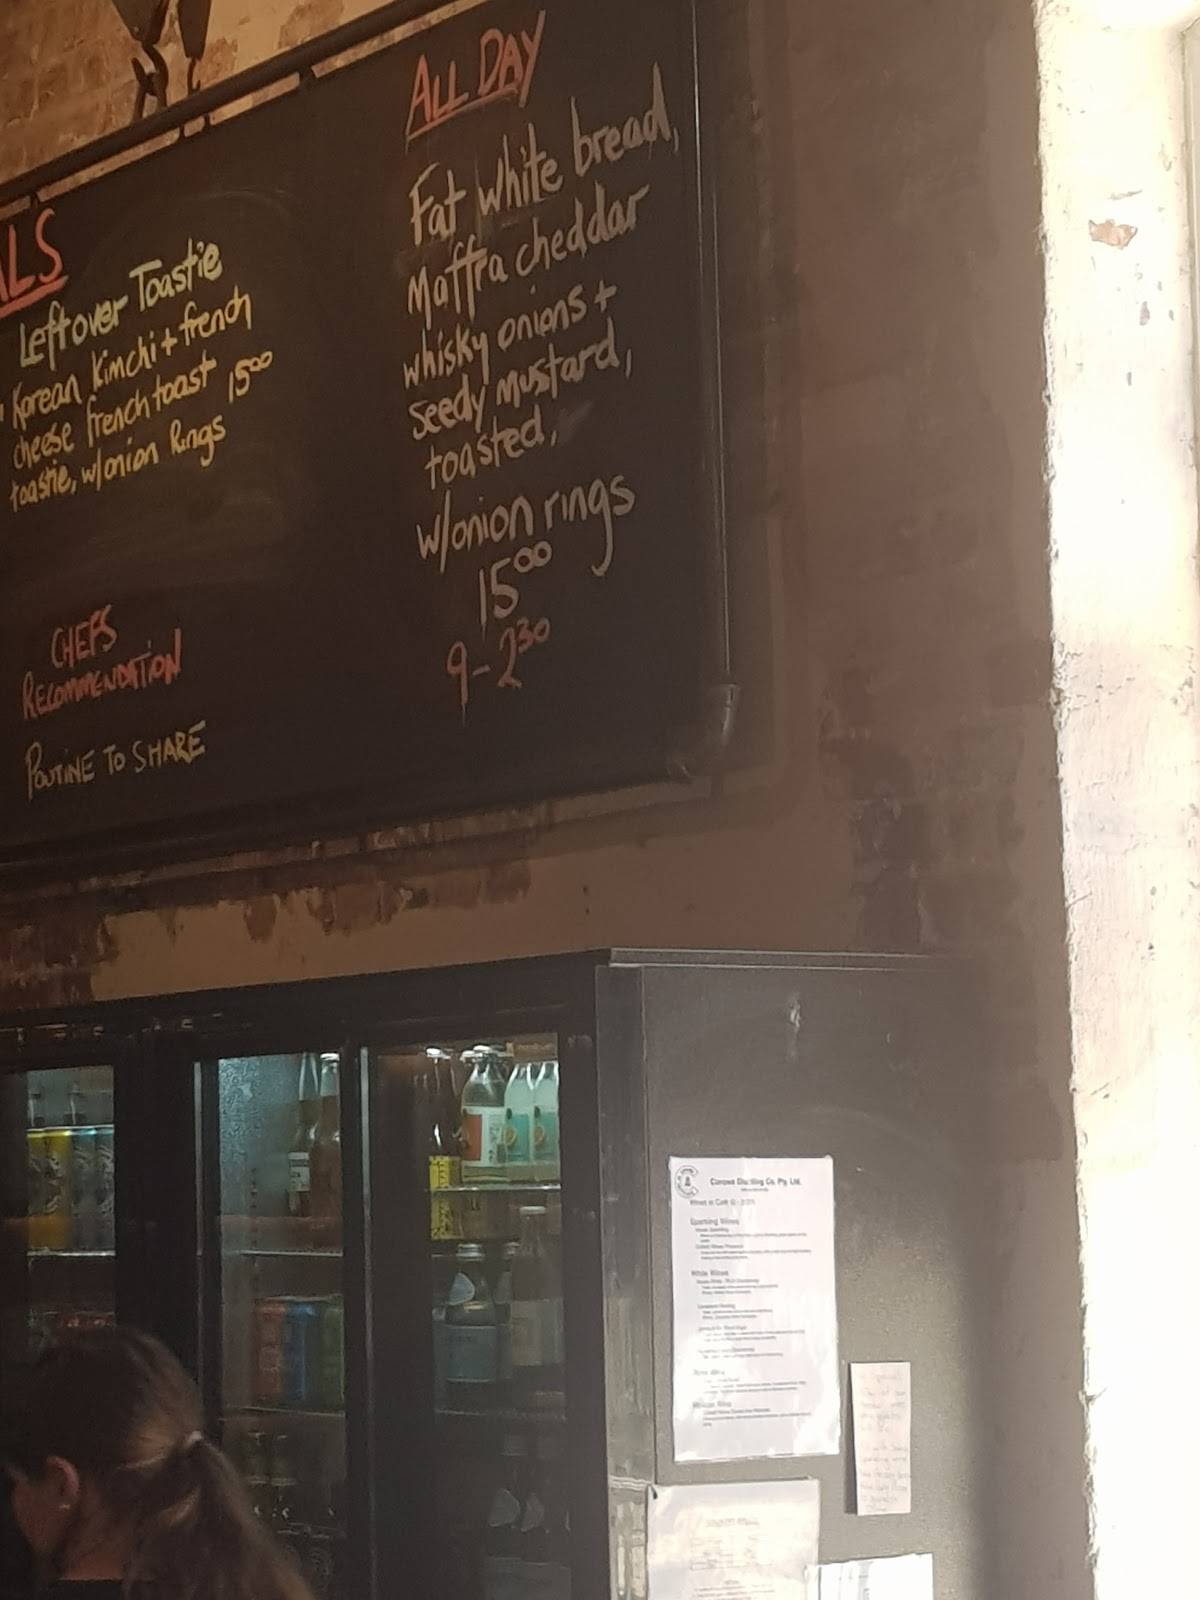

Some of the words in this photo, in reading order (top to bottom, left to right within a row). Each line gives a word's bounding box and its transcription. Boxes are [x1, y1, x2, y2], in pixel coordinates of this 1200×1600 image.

[404, 54, 470, 142] ALL
[478, 10, 546, 108] DAY
[409, 162, 466, 247] Fat
[478, 123, 563, 216] white
[571, 61, 679, 177] bread,
[515, 180, 650, 277] cheddar
[20, 295, 128, 371] Leftover
[129, 237, 223, 312] Toastie
[403, 323, 489, 385] whisky
[497, 284, 587, 351] onions
[12, 374, 82, 431] Korean
[179, 285, 251, 346] french
[152, 350, 217, 411] toast
[424, 403, 557, 490] toasted,
[544, 475, 636, 577] rings
[103, 745, 126, 775] TO
[132, 720, 206, 774] SHARE
